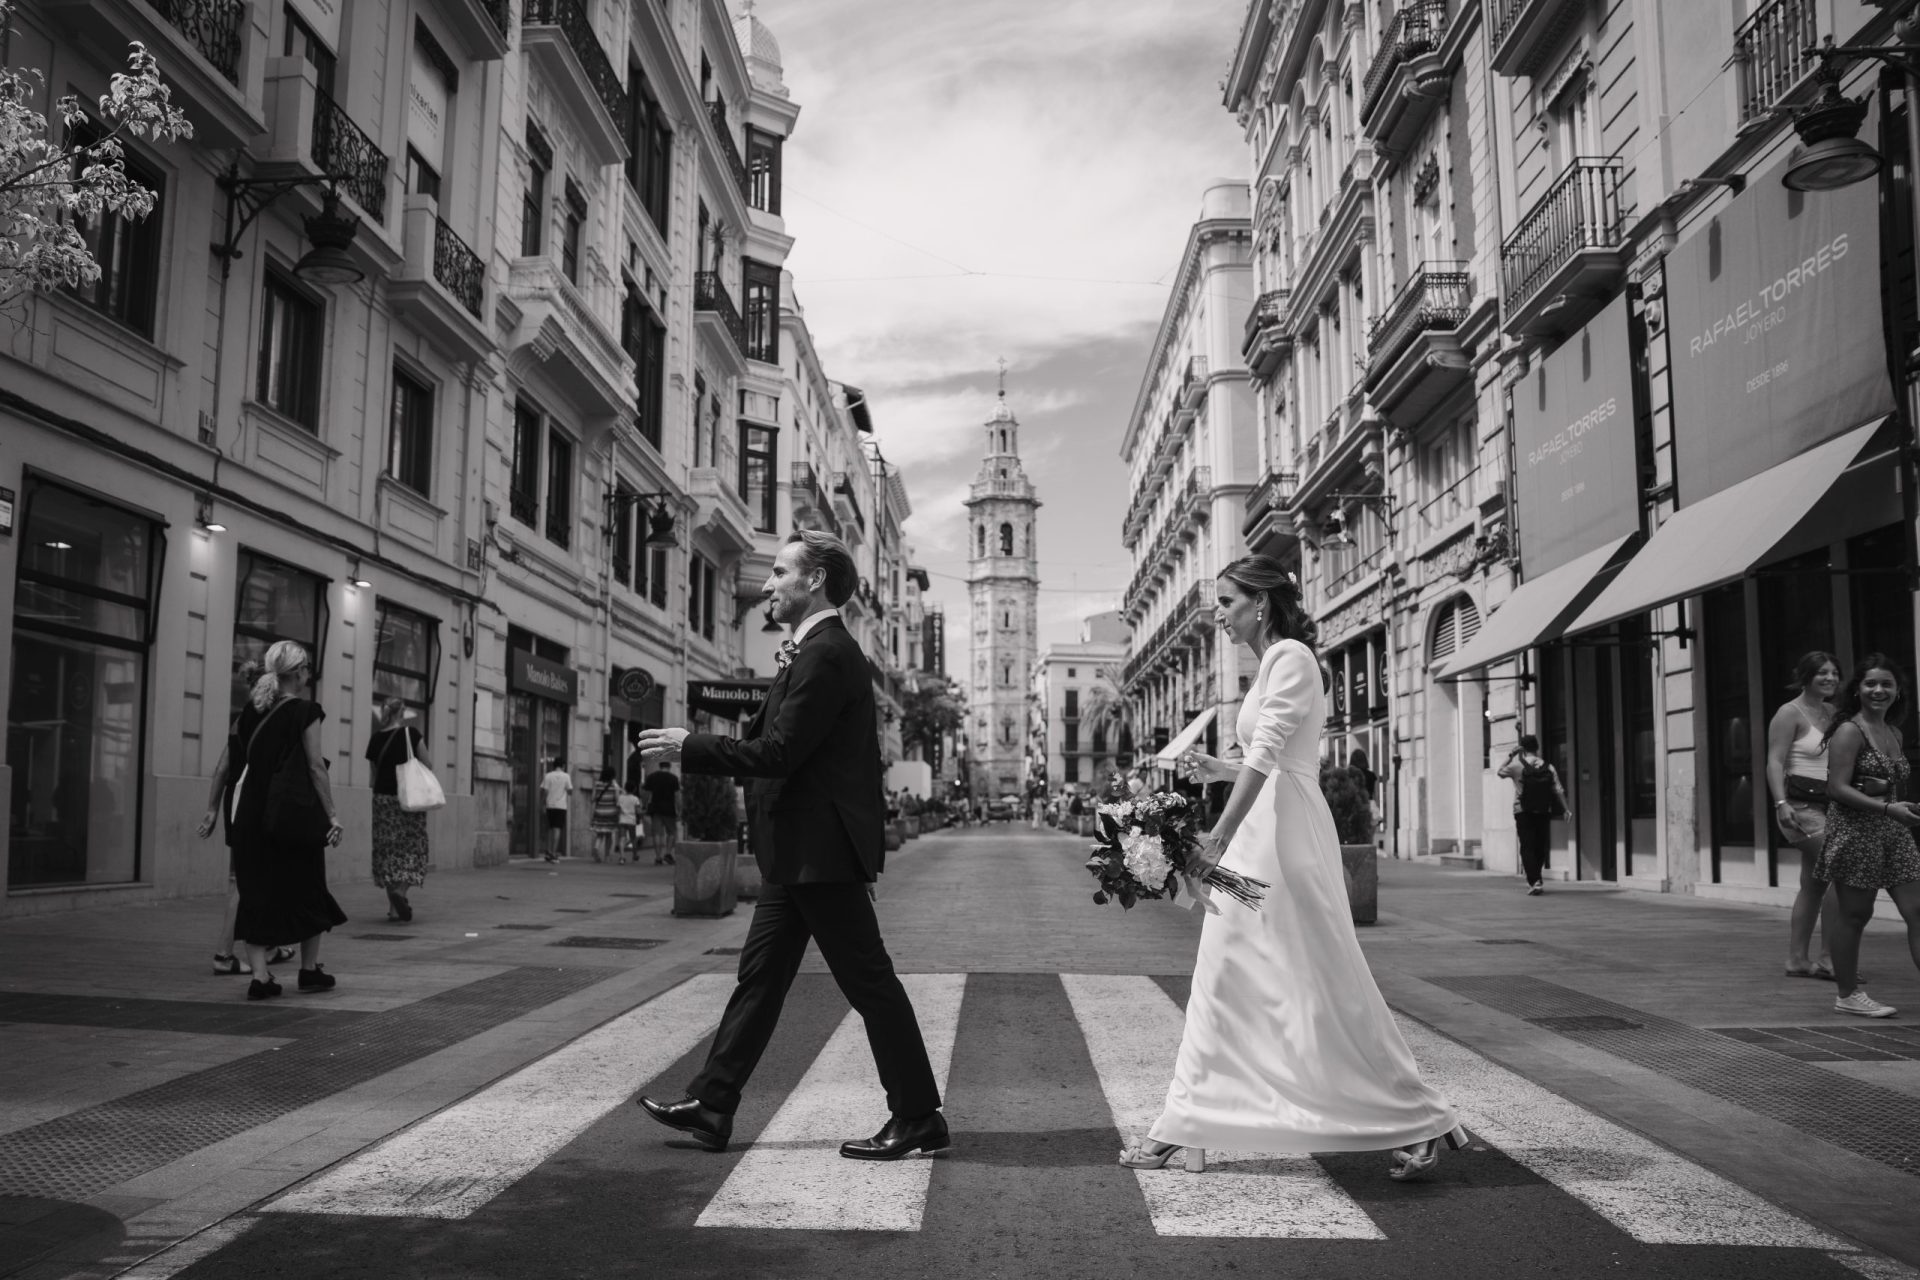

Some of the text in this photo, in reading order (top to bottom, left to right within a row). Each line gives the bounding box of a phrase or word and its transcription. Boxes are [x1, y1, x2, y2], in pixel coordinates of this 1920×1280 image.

[1690, 233, 1848, 358] RAFAEL TORRES
[1744, 306, 1786, 344] JOYERO
[1746, 370, 1771, 393] DESDE
[1528, 398, 1616, 468] RAFAEL TORRES
[702, 686, 750, 700] Manolo
